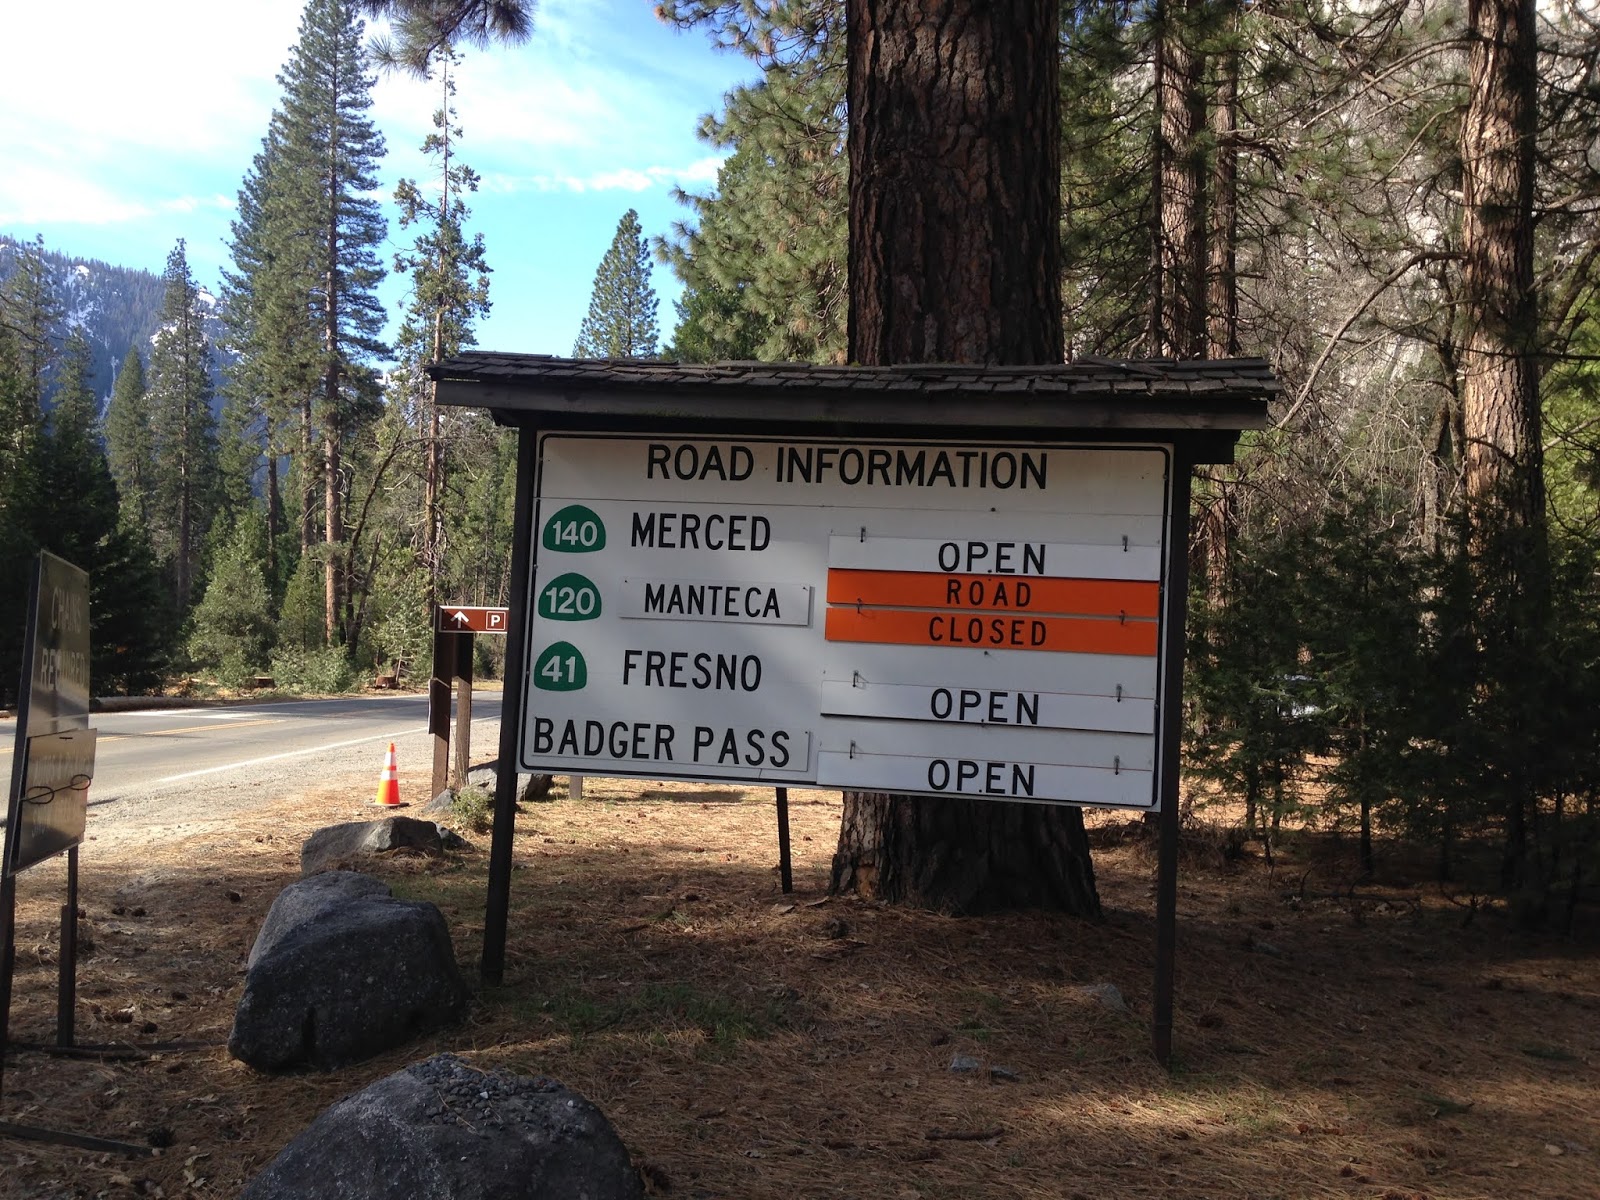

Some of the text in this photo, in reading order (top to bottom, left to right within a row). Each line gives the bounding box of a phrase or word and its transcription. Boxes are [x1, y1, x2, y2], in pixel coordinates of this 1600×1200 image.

[647, 444, 1047, 489] ROAD INFORMATION
[553, 520, 598, 546] 140
[631, 512, 771, 551] MERCED
[938, 541, 1046, 575] OPEN
[546, 586, 595, 615] 120
[644, 583, 780, 618] MANTECA
[946, 579, 1031, 607] ROAD
[490, 614, 500, 627] P
[929, 616, 1047, 646] CLOSED
[541, 655, 576, 683] 41
[623, 649, 762, 692] FRESNO
[930, 688, 1039, 725] OPEN
[533, 717, 789, 768] BADGER PASS
[928, 759, 1035, 796] OPEN
